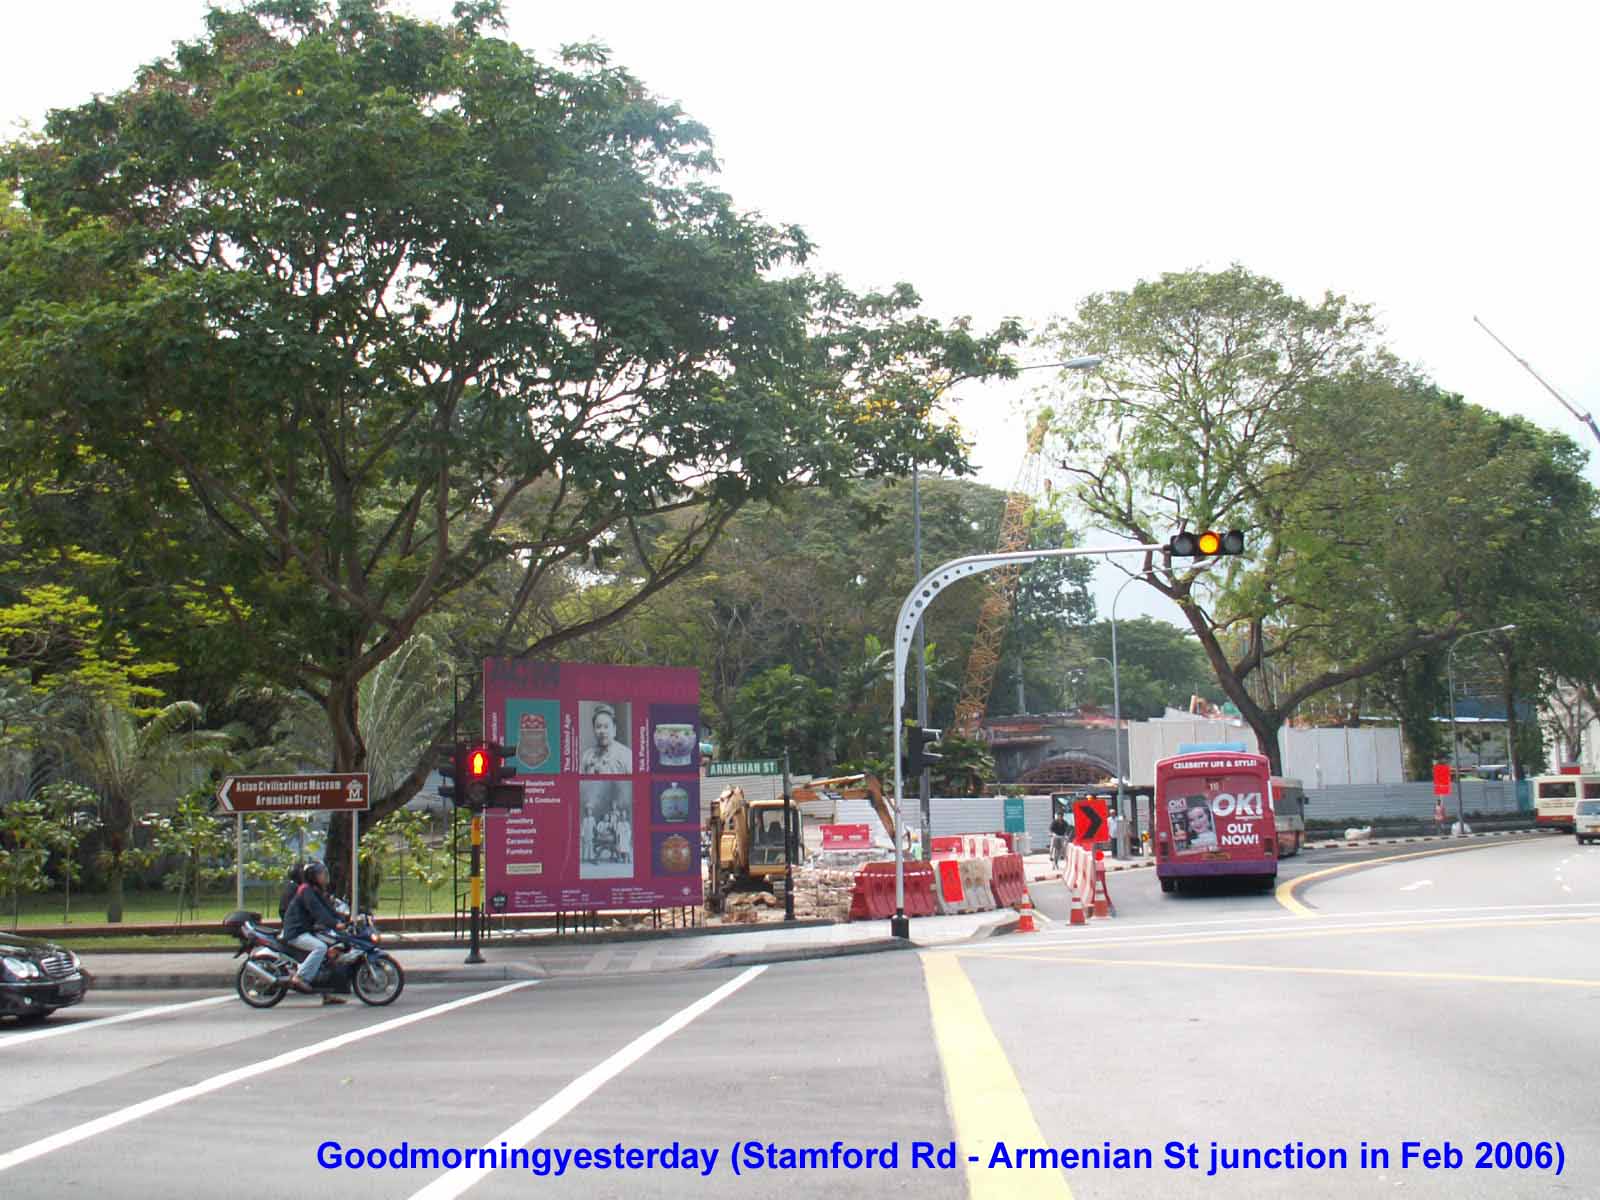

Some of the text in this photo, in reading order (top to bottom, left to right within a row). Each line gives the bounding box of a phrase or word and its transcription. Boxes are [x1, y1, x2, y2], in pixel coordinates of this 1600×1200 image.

[710, 762, 760, 776] ARMENIAN
[1173, 759, 1257, 769] CELEBRITY LIFE & STYLE!
[236, 781, 257, 792] Asian
[309, 778, 342, 791] Museum
[256, 793, 321, 806] Armenian Street
[1168, 798, 1187, 809] OK!
[1212, 792, 1263, 817] OK!
[1227, 823, 1253, 834] OUT
[1221, 834, 1260, 846] NOW!
